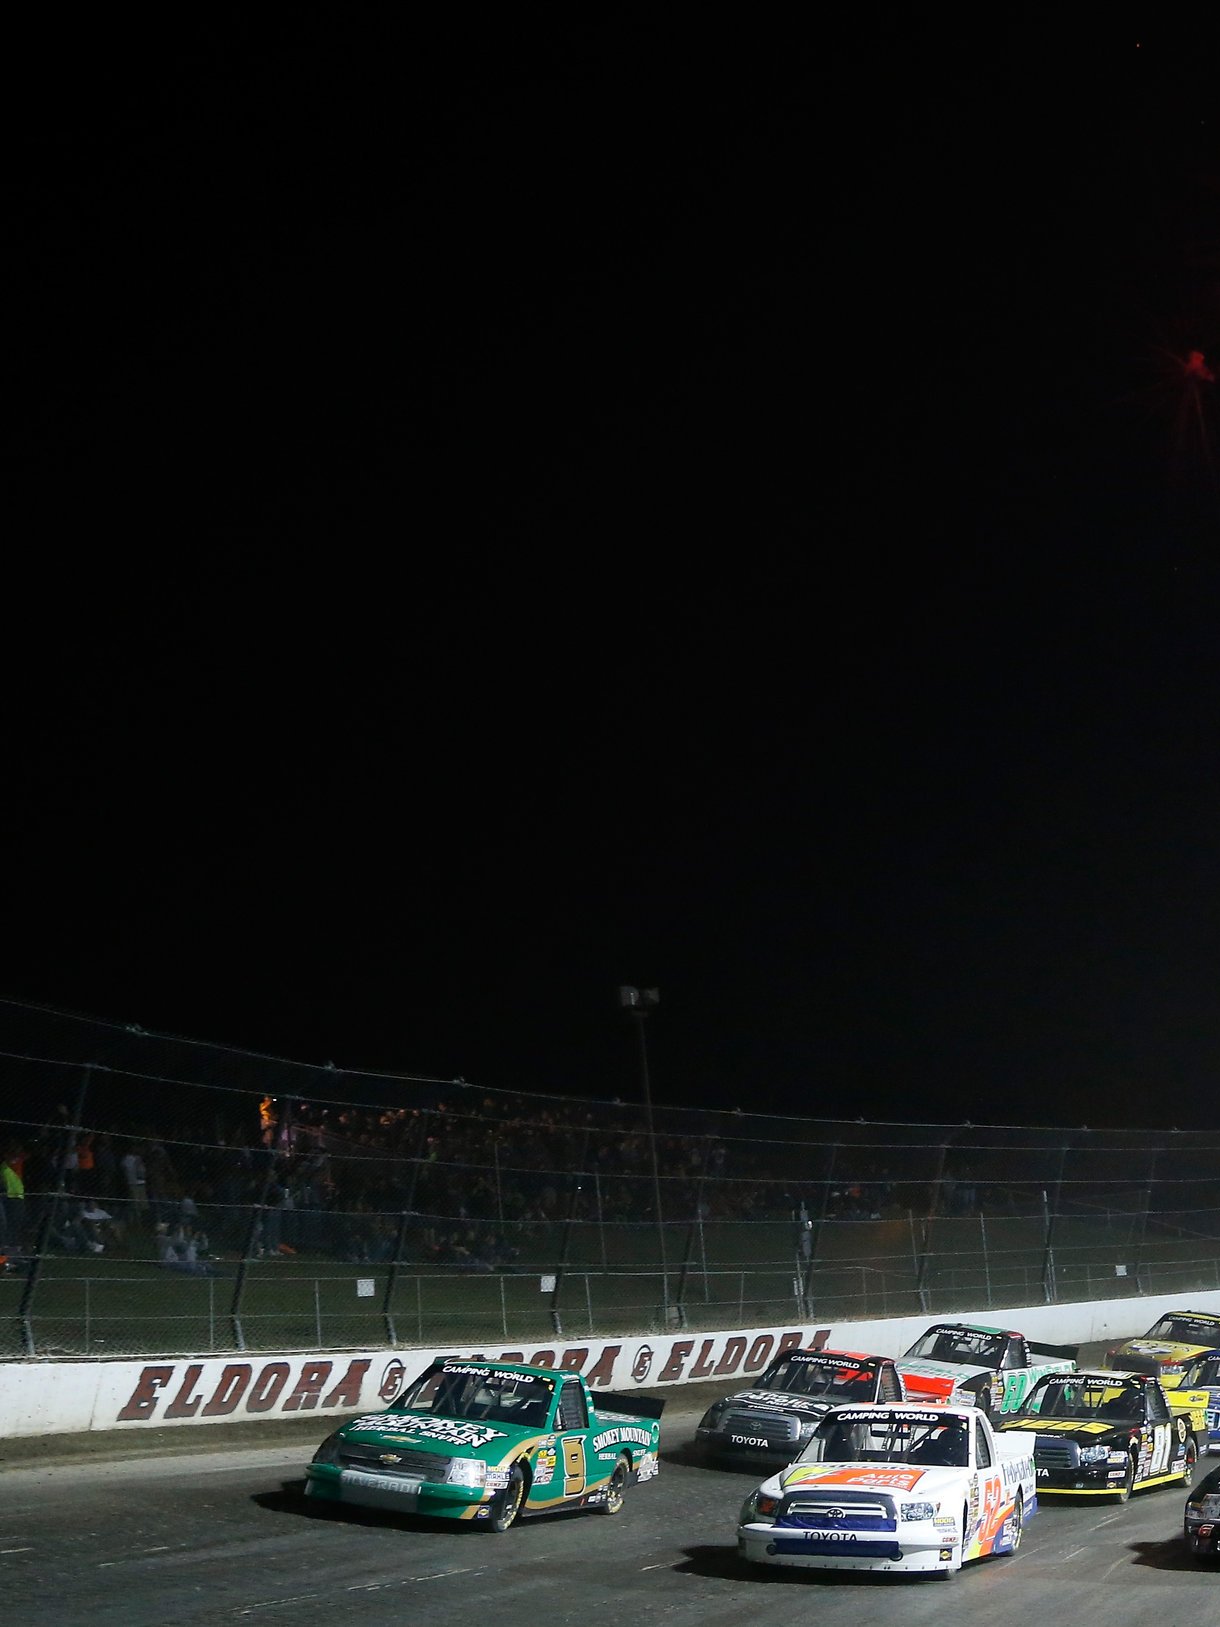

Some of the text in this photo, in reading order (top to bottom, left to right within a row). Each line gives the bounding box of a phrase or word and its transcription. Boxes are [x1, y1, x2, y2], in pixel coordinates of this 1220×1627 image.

[935, 1328, 992, 1341] CAMPING WORLD
[790, 1355, 860, 1369] CAMPING WORLD
[442, 1365, 535, 1383] CAMPING WORLD
[1049, 1377, 1123, 1387] CAMPING WORLD
[117, 1358, 372, 1422] ELDORA
[836, 1412, 939, 1422] CAMPING WORLD
[352, 1419, 488, 1448] MOUNTAIN
[361, 1414, 508, 1438] SMOKEY
[1000, 1418, 1115, 1434] JEGS
[592, 1426, 652, 1453] SMOKEY MOUNTAIN
[731, 1434, 769, 1448] TOYOTA
[560, 1435, 587, 1498] 9
[978, 1475, 1002, 1545] 52
[803, 1531, 858, 1541] TOYOTA
